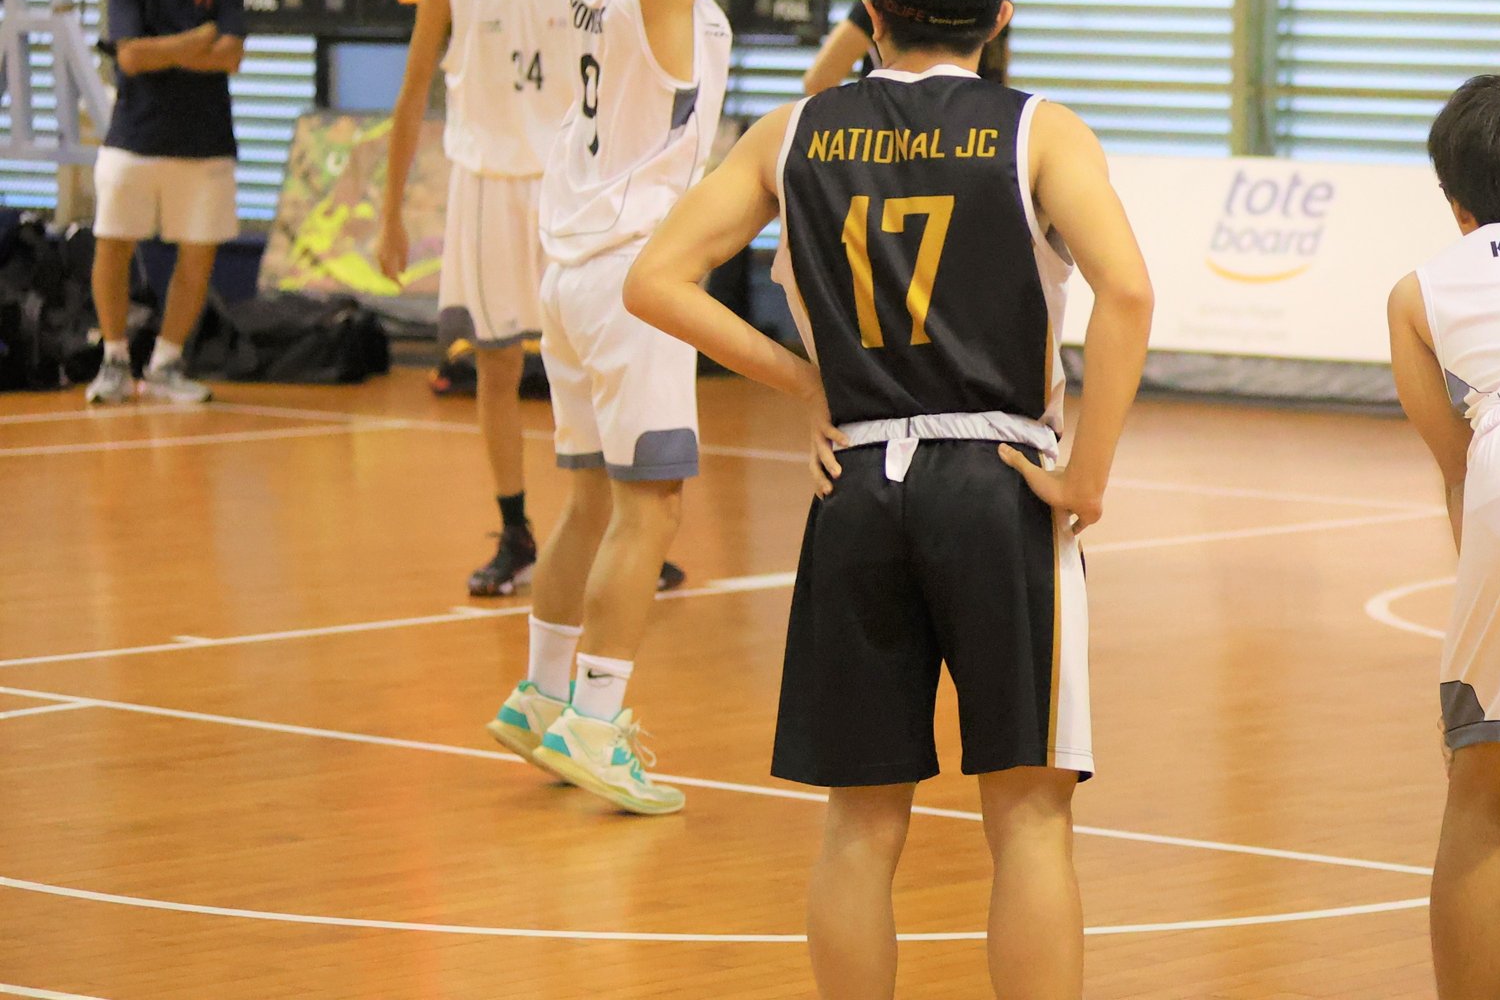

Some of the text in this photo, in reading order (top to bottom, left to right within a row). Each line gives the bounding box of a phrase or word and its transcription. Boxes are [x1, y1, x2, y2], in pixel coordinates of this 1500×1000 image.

[807, 128, 998, 163] NATIONAL JC
[1225, 169, 1335, 219] tote
[1210, 220, 1325, 257] board
[841, 195, 955, 348] 17
